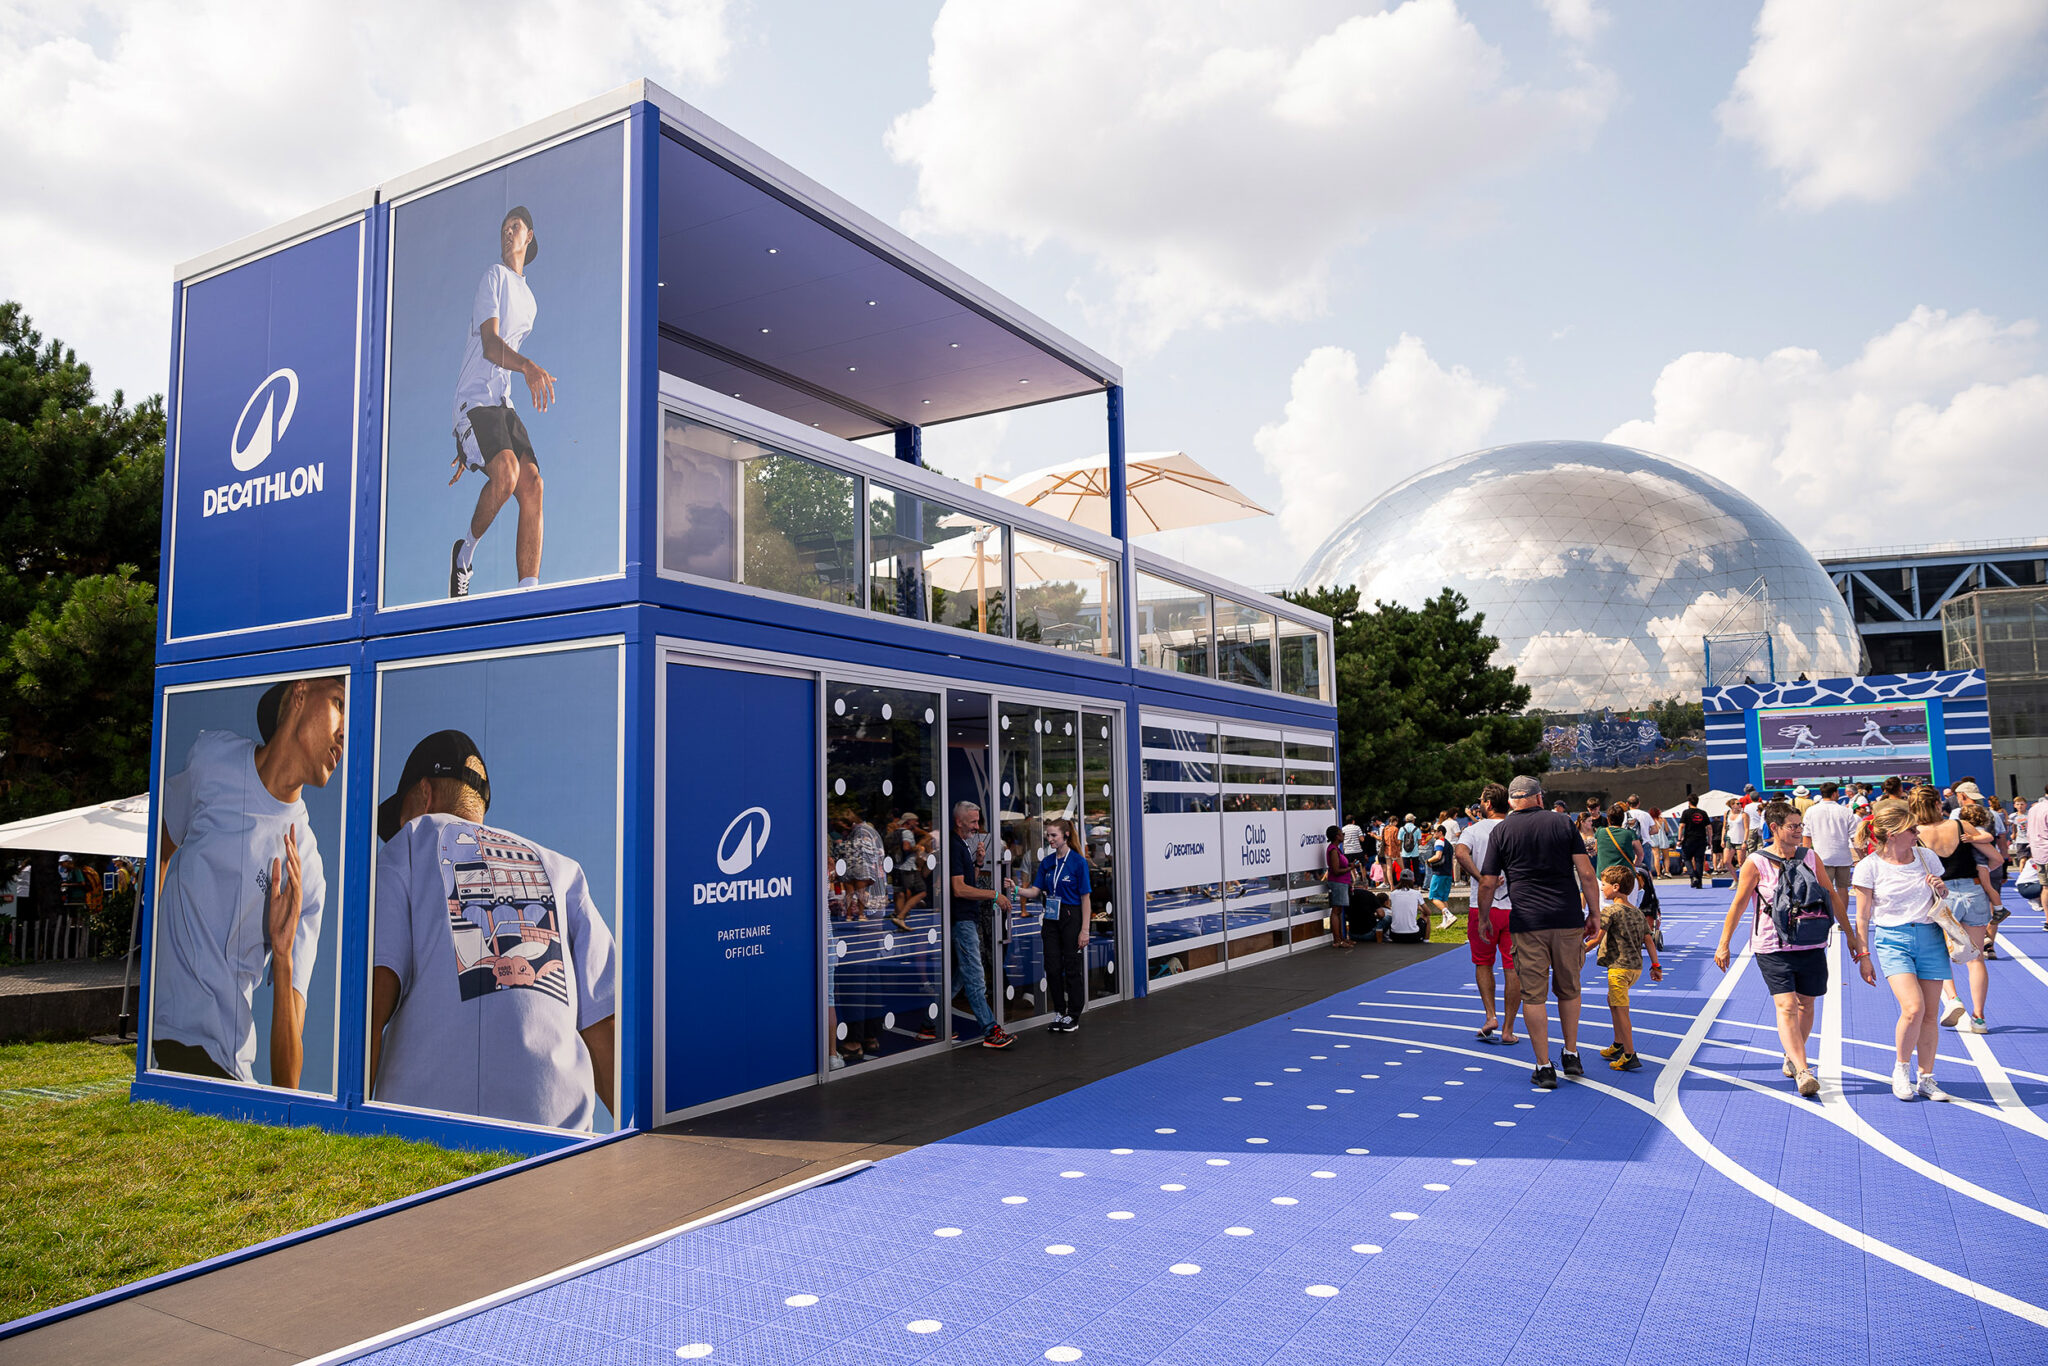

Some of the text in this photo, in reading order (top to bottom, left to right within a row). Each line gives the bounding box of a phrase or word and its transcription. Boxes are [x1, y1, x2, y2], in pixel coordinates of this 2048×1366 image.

[203, 462, 324, 518] DECATHLON
[1245, 824, 1266, 845] Club
[1173, 843, 1204, 856] DECATHLON
[1242, 846, 1271, 866] House
[693, 877, 792, 905] DECATHLON
[718, 925, 771, 942] PARTENAIRE
[725, 944, 765, 960] OFFICIEL
